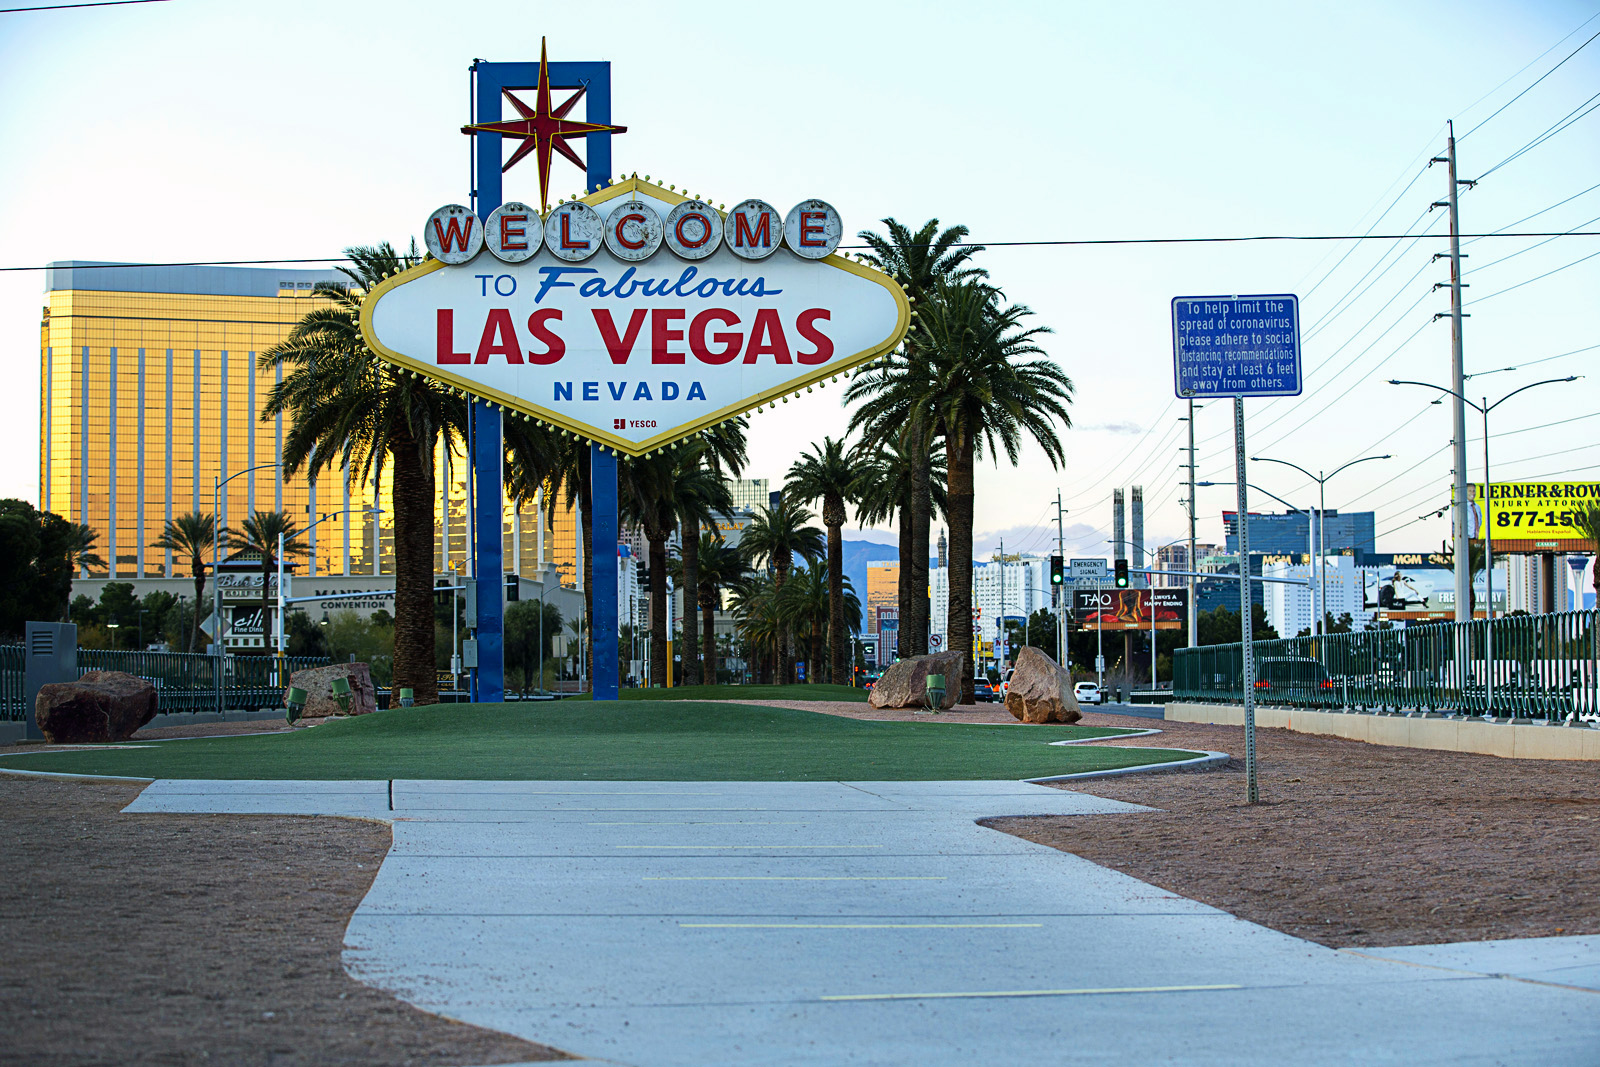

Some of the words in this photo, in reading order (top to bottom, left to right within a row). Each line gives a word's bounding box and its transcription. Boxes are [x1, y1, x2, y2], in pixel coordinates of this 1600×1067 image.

[434, 210, 829, 253] WELCOME
[475, 274, 517, 297] TO
[534, 265, 783, 304] Fabulous
[1187, 302, 1200, 314] To
[1204, 301, 1229, 317] help
[1234, 301, 1261, 313] limit
[1265, 300, 1284, 313] the
[1180, 318, 1214, 333] spread
[1217, 317, 1227, 329] of
[436, 308, 567, 365] LAS
[590, 308, 835, 365] VEGAS
[1180, 334, 1211, 349] please
[1215, 333, 1248, 345] adhere
[1252, 333, 1262, 344] to
[1265, 332, 1294, 344] social
[1181, 349, 1222, 365] distancing
[1224, 347, 1293, 361] recommendations
[1182, 365, 1199, 377] and
[1202, 365, 1223, 379] stay
[1227, 363, 1237, 376] at
[1240, 363, 1263, 375] least
[1267, 363, 1273, 375] 6
[1277, 362, 1294, 375] feet
[553, 381, 707, 401] NEVADA
[1193, 379, 1218, 392] away
[1223, 378, 1246, 389] from
[1250, 377, 1285, 388] others.
[629, 419, 657, 428] YESCO
[1493, 500, 1530, 508] NJURY
[699, 522, 745, 531] ADALAY
[710, 534, 727, 543] BY
[1262, 555, 1292, 565] MGM
[1393, 554, 1422, 565] MGM
[1428, 554, 1455, 565] GRA
[315, 589, 395, 601] MANDALA
[1079, 593, 1112, 606] TAO
[1438, 592, 1455, 603] FRE
[320, 601, 386, 609] CONVENTION
